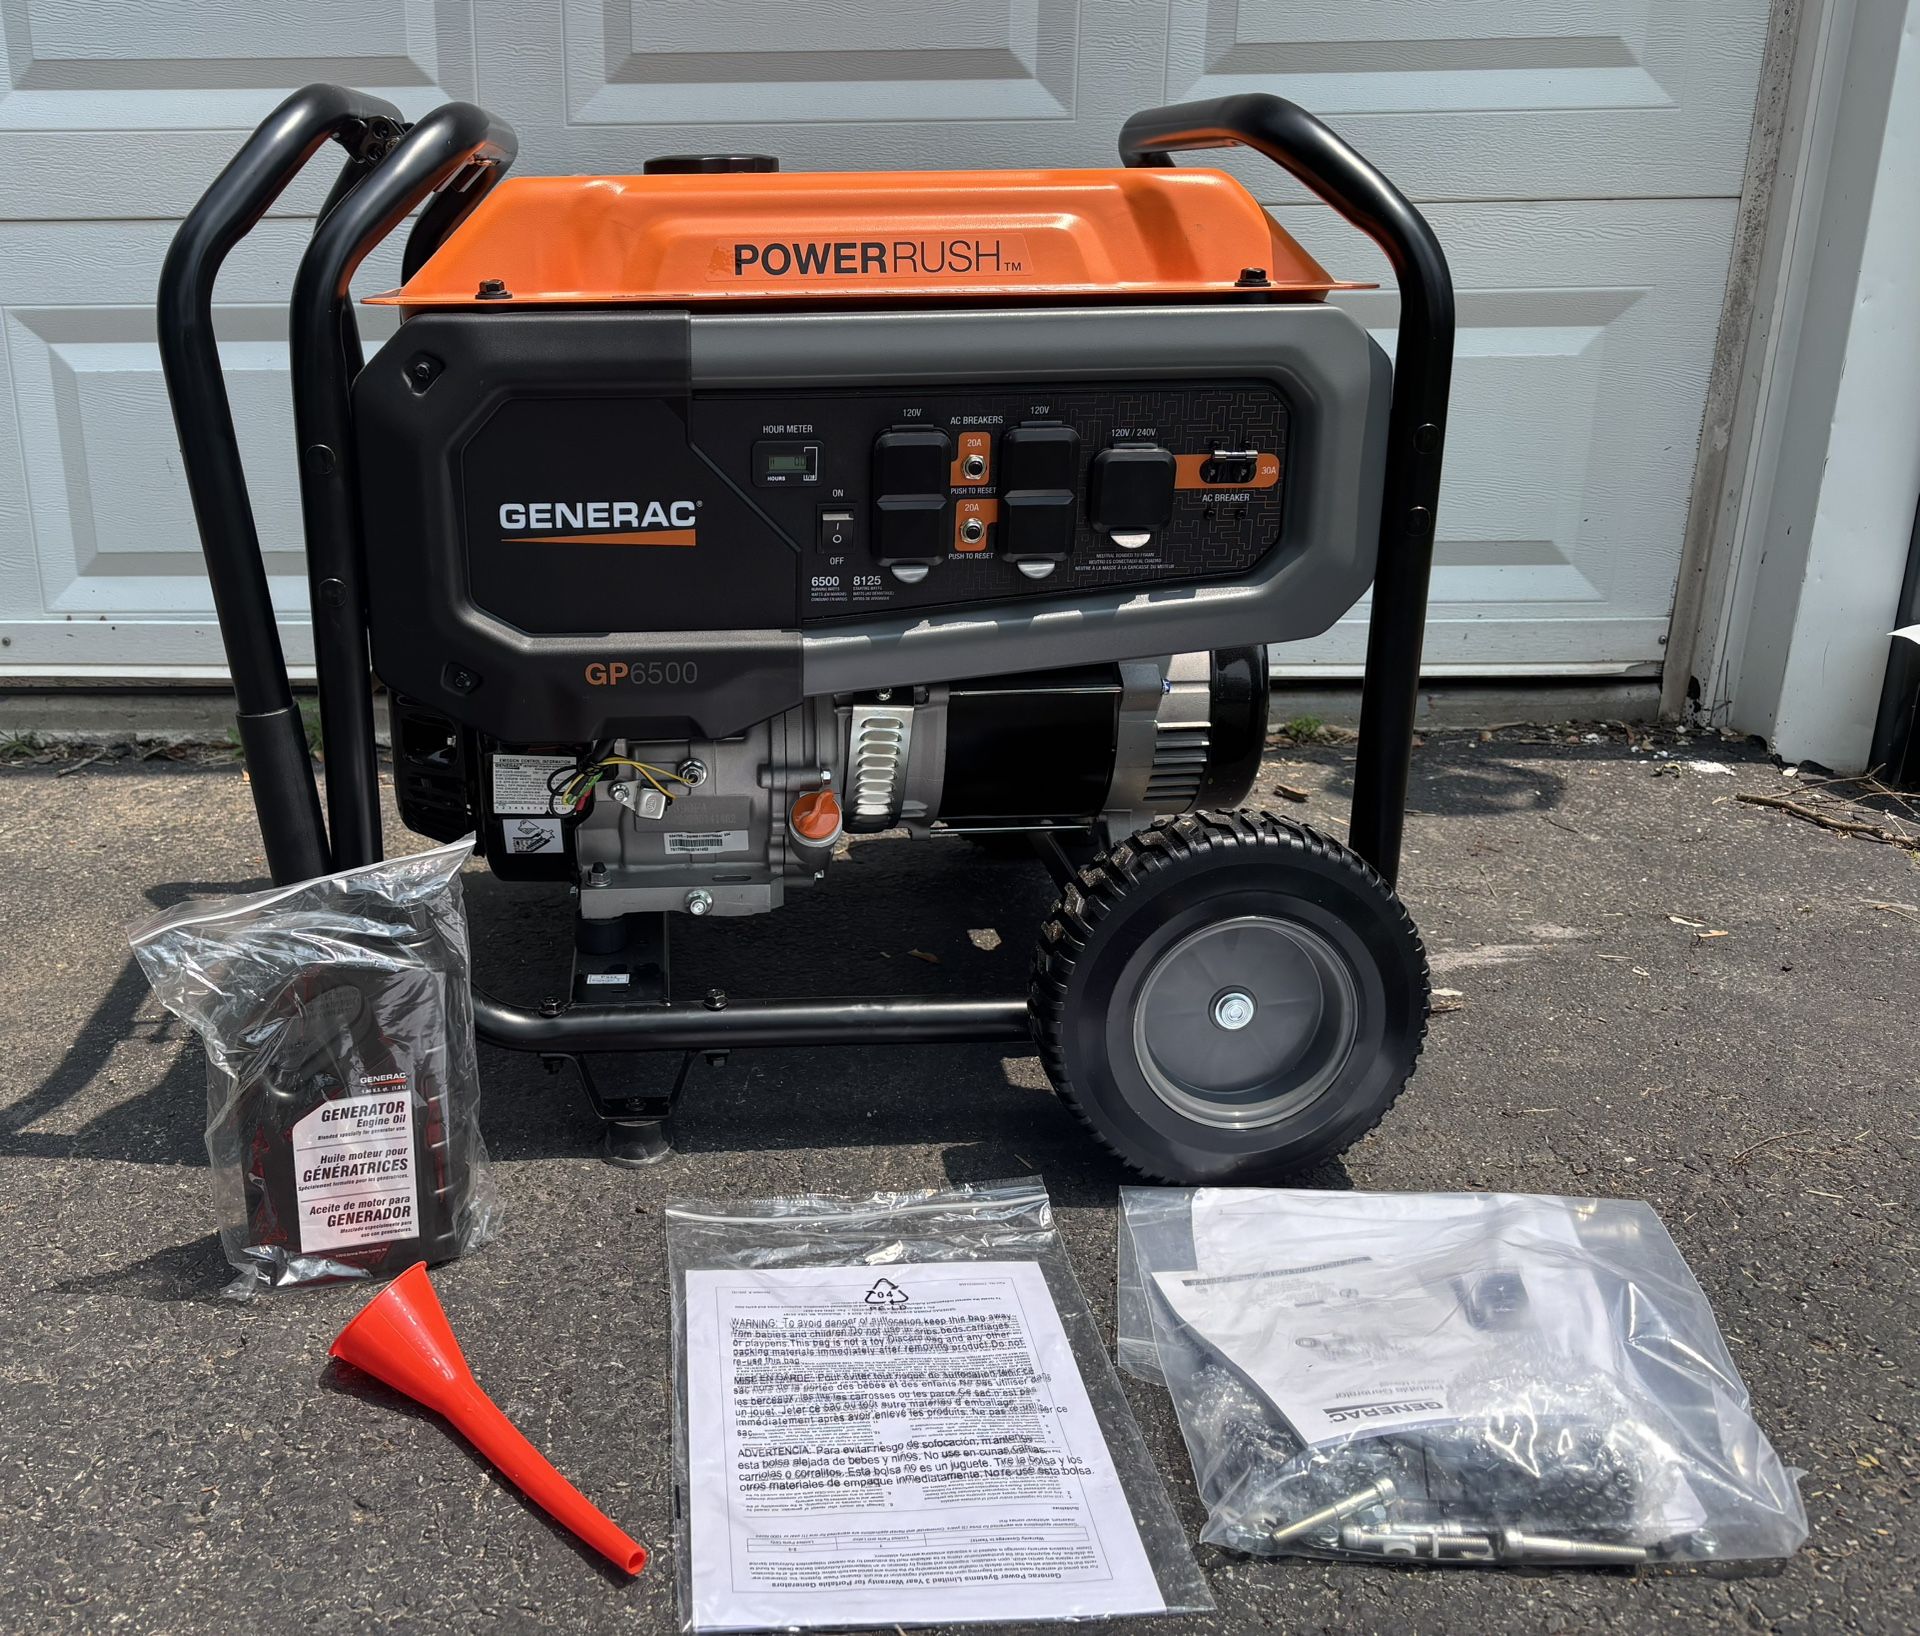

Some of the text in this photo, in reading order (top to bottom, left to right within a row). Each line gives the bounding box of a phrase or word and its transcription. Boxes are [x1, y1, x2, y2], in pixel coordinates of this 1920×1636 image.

[903, 409, 922, 417] 120V
[1030, 406, 1050, 414] 120V
[950, 416, 1004, 424] AC BREAKERS
[762, 425, 813, 434] HOUR METER
[1112, 428, 1156, 437] 120V 240V
[967, 439, 982, 447] 20A
[1261, 466, 1277, 474] 30A
[832, 490, 844, 498] ON
[950, 487, 967, 495] PUSH
[1202, 493, 1250, 502] AC BREAKER
[964, 504, 980, 512] 20A
[500, 501, 696, 530] GENERAC
[830, 557, 844, 565] OFF
[974, 552, 994, 560] RESET
[811, 576, 882, 586] 6500 8125
[584, 661, 698, 686] GP6500
[360, 1072, 406, 1084] GENERAC
[321, 1100, 405, 1122] GENERATOR
[356, 1114, 406, 1128] Engine Oil
[320, 1147, 408, 1164] Huile moteur pour
[303, 1158, 408, 1182] GÉNÉRATRICES
[310, 1196, 410, 1216] Aceite de motor para
[327, 1205, 412, 1228] GENERADOR
[783, 1317, 794, 1328] To
[798, 1317, 822, 1328] avoid
[825, 1318, 856, 1328] danger
[924, 1316, 946, 1326] keep
[948, 1314, 966, 1324] this
[968, 1314, 986, 1323] bag
[755, 1329, 787, 1338] babies
[790, 1329, 807, 1338] and
[812, 1339, 830, 1348] bag
[833, 1338, 841, 1346] is
[844, 1338, 858, 1346] not
[946, 1334, 964, 1344] and
[966, 1333, 983, 1342] any
[986, 1330, 1010, 1340] other
[732, 1348, 769, 1358] packing
[772, 1348, 815, 1356] materials
[818, 1346, 875, 1356] immediately
[879, 1344, 902, 1354] after
[905, 1342, 948, 1352] removing
[732, 1356, 781, 1366] re-use this
[734, 1376, 758, 1385] MISE
[818, 1373, 840, 1382] Pour
[928, 1371, 940, 1379] de
[837, 1382, 854, 1390] des
[889, 1380, 898, 1388] et
[900, 1380, 918, 1388] des
[734, 1397, 750, 1406] les
[850, 1392, 896, 1402] carrosses
[782, 1406, 806, 1415] Jeter
[881, 1400, 906, 1410] autre
[1329, 1401, 1444, 1422] GENERAC
[736, 1416, 814, 1426] immédiatement
[972, 1408, 986, 1416] Ne
[988, 1408, 1006, 1417] pas
[816, 1446, 840, 1455] Para
[842, 1444, 870, 1454] evitar
[738, 1460, 760, 1470] esta
[762, 1458, 790, 1469] bolsa
[792, 1456, 830, 1468] alejada
[832, 1456, 846, 1466] de
[848, 1455, 880, 1465] bebes
[882, 1456, 889, 1466] y
[924, 1450, 939, 1460] No
[942, 1450, 960, 1458] use
[963, 1449, 976, 1457] en
[785, 1471, 792, 1480] o
[848, 1467, 871, 1477] Esta
[920, 1463, 932, 1472] es
[934, 1462, 948, 1471] un
[950, 1458, 992, 1472] juguete.
[1058, 1456, 1065, 1467] y
[1068, 1454, 1082, 1465] los
[740, 1482, 766, 1492] otros
[769, 1480, 824, 1490] materiales
[827, 1478, 840, 1487] de
[844, 1476, 894, 1490] empaque
